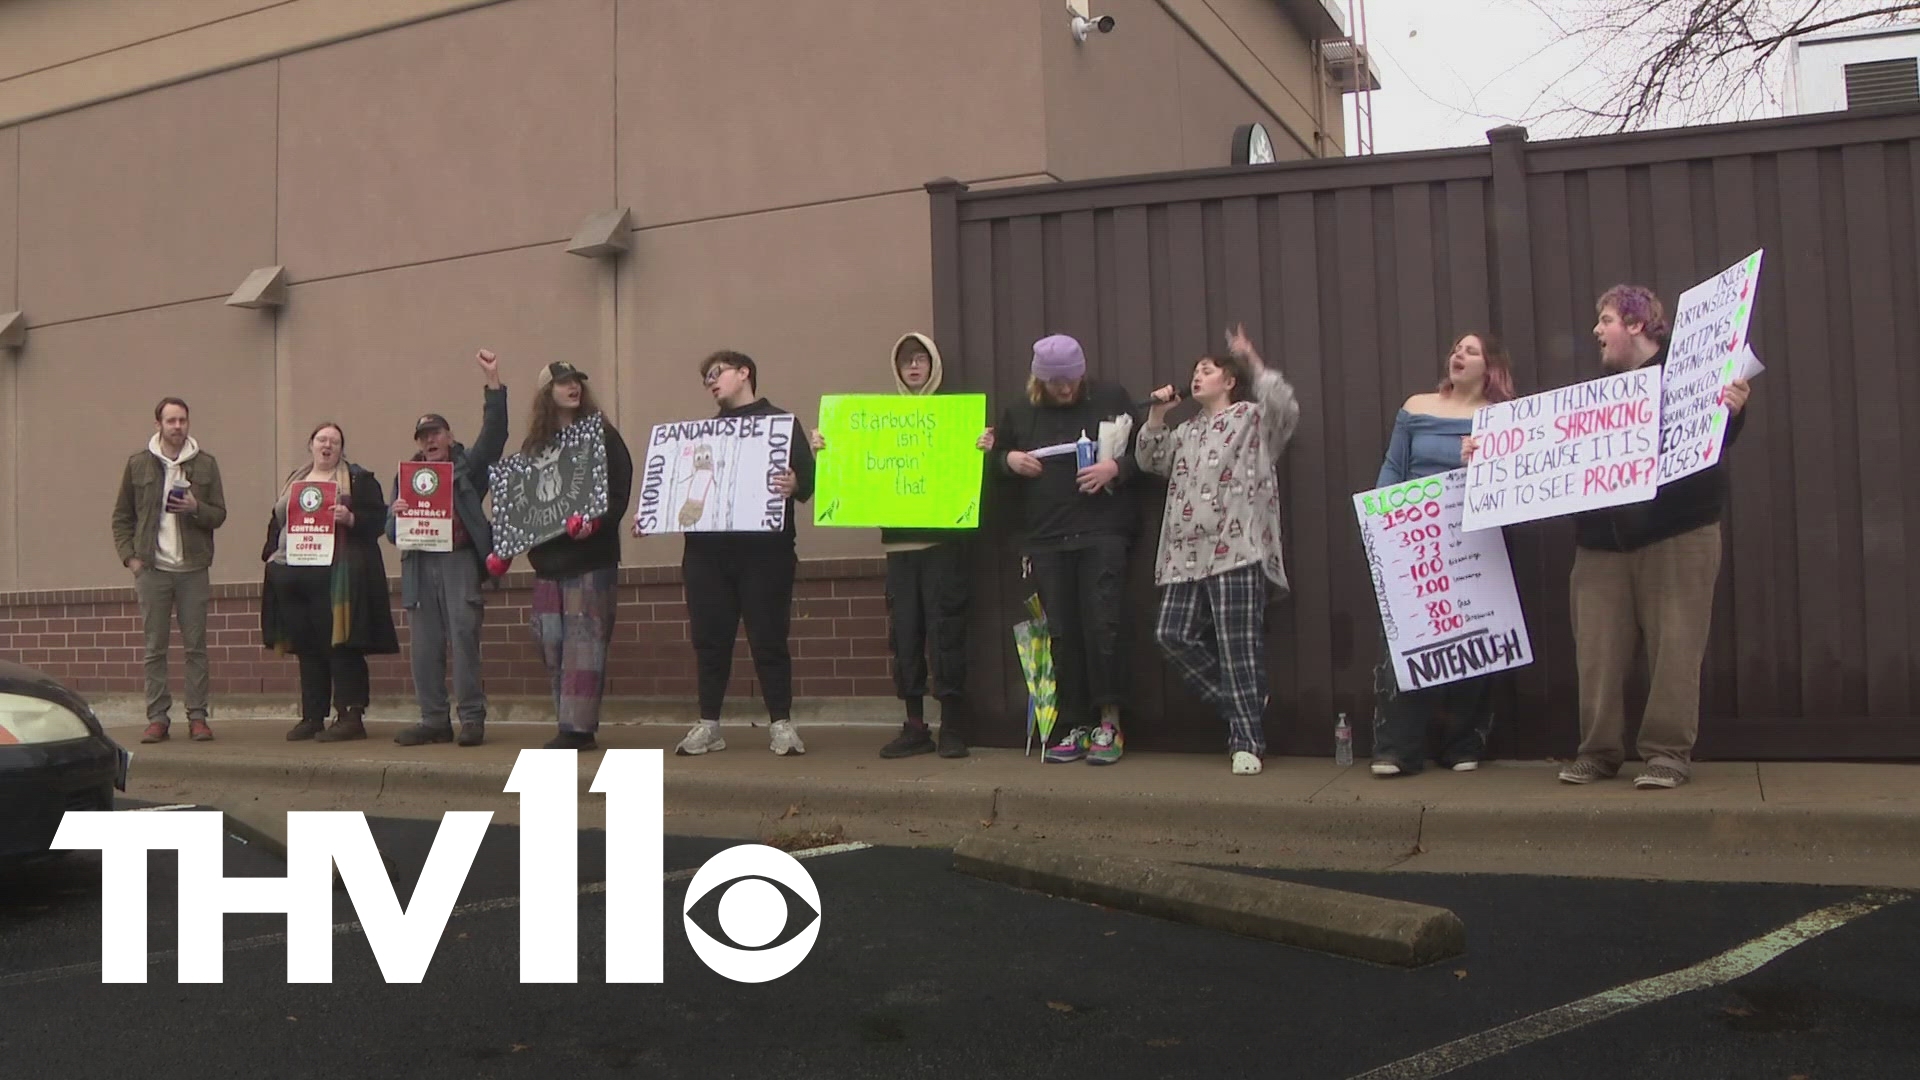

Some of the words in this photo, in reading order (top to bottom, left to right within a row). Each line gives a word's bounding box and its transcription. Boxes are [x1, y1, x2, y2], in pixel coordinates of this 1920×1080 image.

[1710, 284, 1738, 312] SIZES
[1671, 332, 1696, 359] WAIT
[1700, 311, 1732, 346] TIMES
[1477, 405, 1496, 430] IF
[1510, 396, 1541, 422] YOU
[1551, 379, 1609, 415] THINK
[1613, 373, 1648, 400] OUR
[850, 409, 936, 430] starbucks
[1471, 428, 1524, 463] FOOD
[1528, 425, 1545, 441] IS
[1554, 397, 1653, 444] SHRINKING
[896, 431, 934, 448] isn't
[1660, 424, 1683, 455] EO
[866, 451, 926, 477] bumpin'
[1471, 459, 1508, 488] ITS
[1514, 442, 1584, 480] BECAUSE
[1591, 434, 1617, 461] IT
[1620, 427, 1650, 455] IS
[1658, 441, 1702, 480] AISES
[638, 454, 666, 530] SHOULD
[654, 418, 738, 446] BANDAIDS
[739, 416, 767, 438] BE
[895, 475, 926, 496] that
[1469, 489, 1506, 514] WANT
[1514, 483, 1534, 505] TO
[1539, 472, 1575, 501] SEE
[1582, 457, 1655, 496] PROOF?
[402, 509, 447, 517] CONTRACT
[418, 500, 431, 509] NO
[513, 478, 529, 512] THE
[523, 505, 557, 527] SIREN
[557, 497, 570, 517] IS
[303, 517, 315, 525] NO
[409, 528, 439, 536] COFFEE
[418, 520, 430, 528] NO
